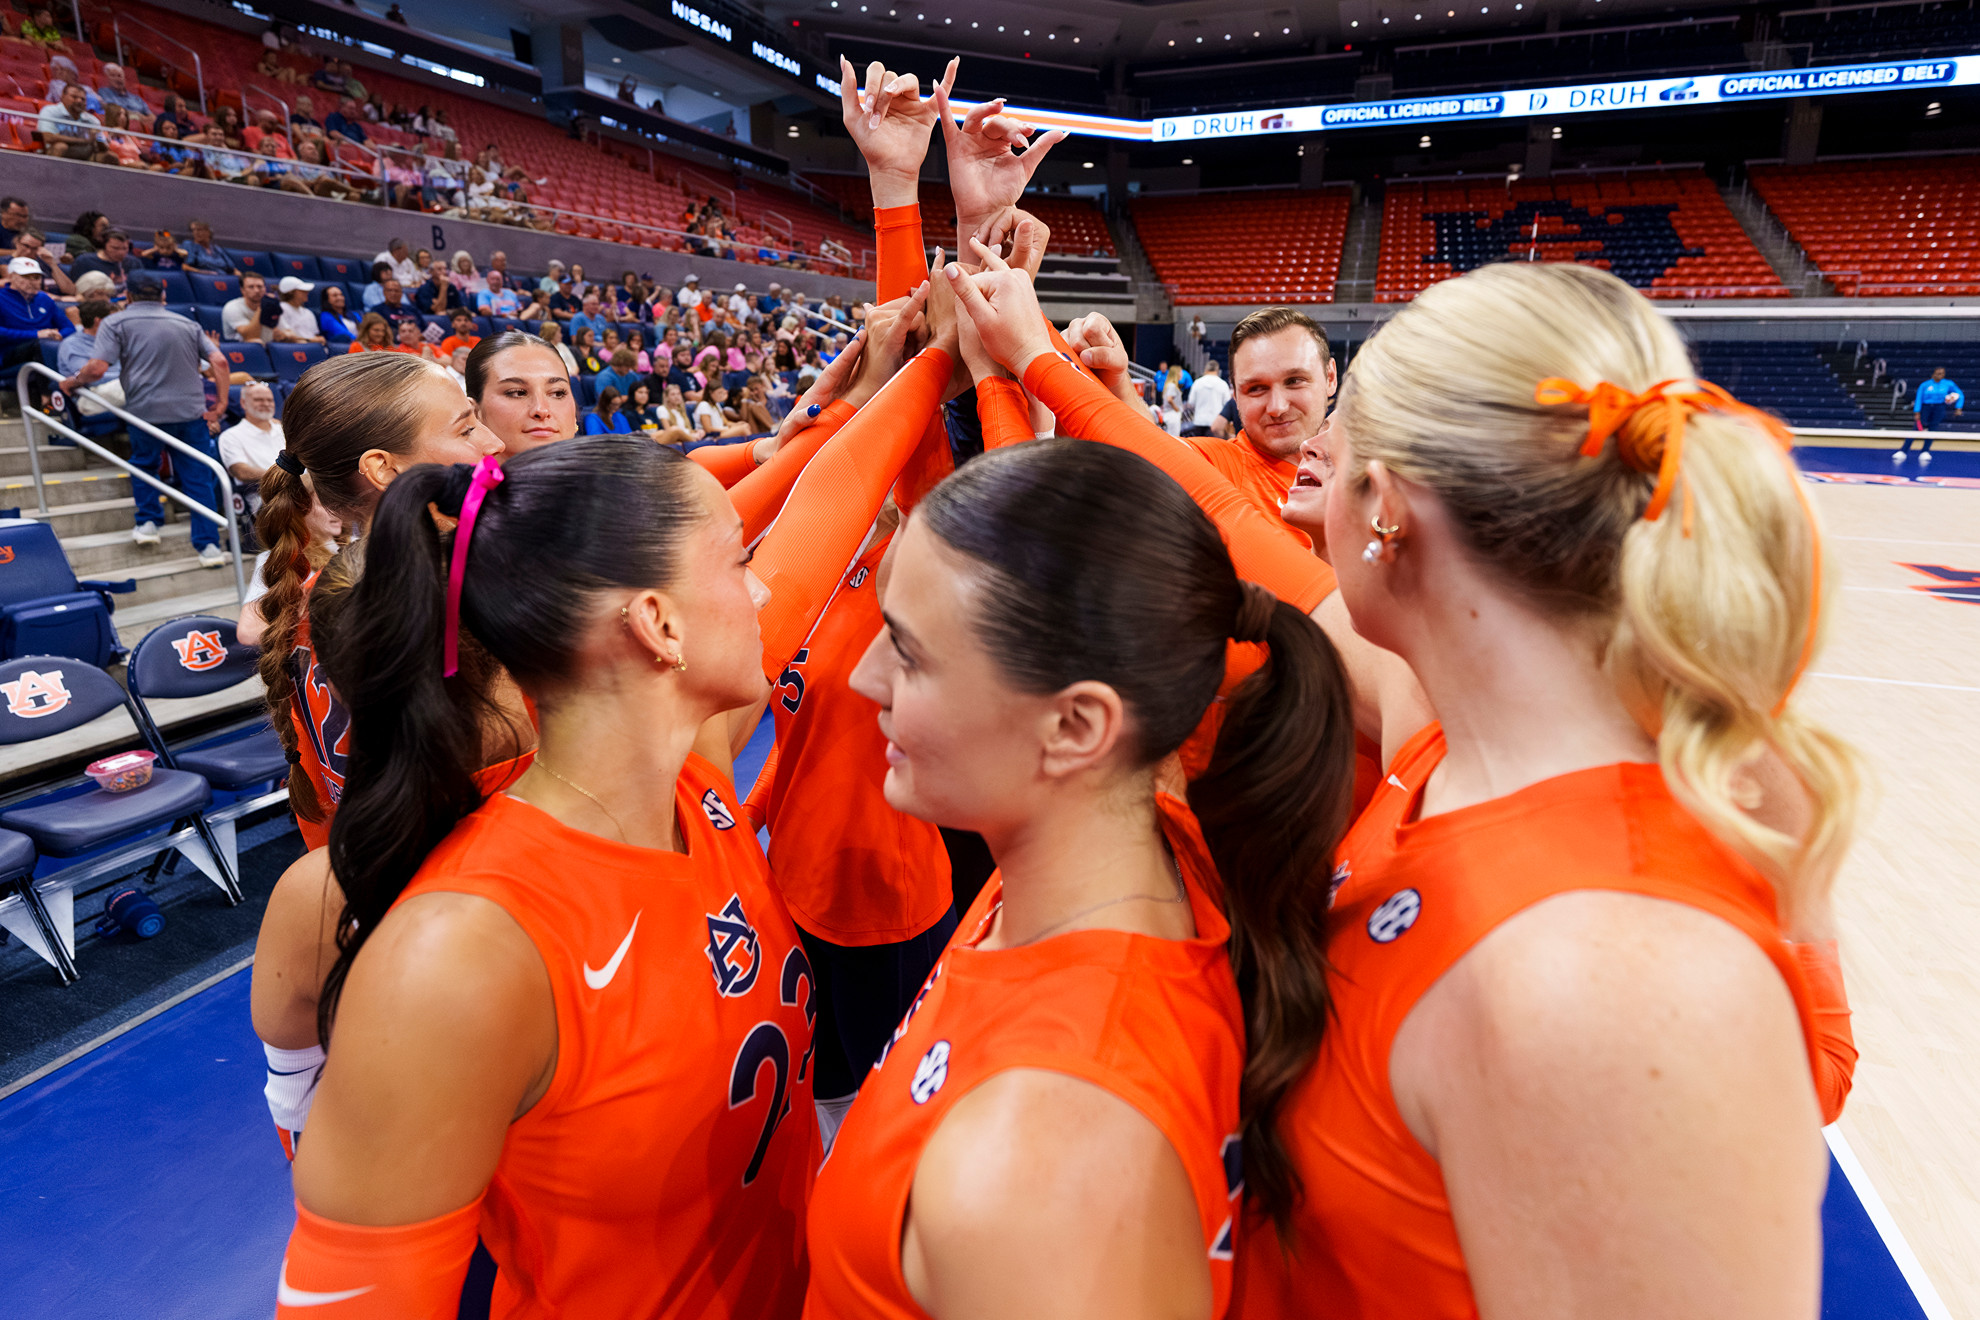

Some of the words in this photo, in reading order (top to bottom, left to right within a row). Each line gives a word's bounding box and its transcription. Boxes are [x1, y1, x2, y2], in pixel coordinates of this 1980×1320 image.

[672, 0, 732, 42] NISSAN
[752, 41, 801, 76] NISSAN
[816, 73, 842, 97] NISS
[1725, 72, 1804, 95] OFFICIAL
[1807, 68, 1898, 88] LICENSED
[1902, 64, 1949, 81] BELT
[1569, 84, 1647, 108] DRUH
[1325, 106, 1388, 123] OFFICIAL
[1390, 101, 1460, 119] LICENSED
[1463, 97, 1499, 113] BELT
[1193, 116, 1254, 135] DRUH
[431, 224, 446, 251] B
